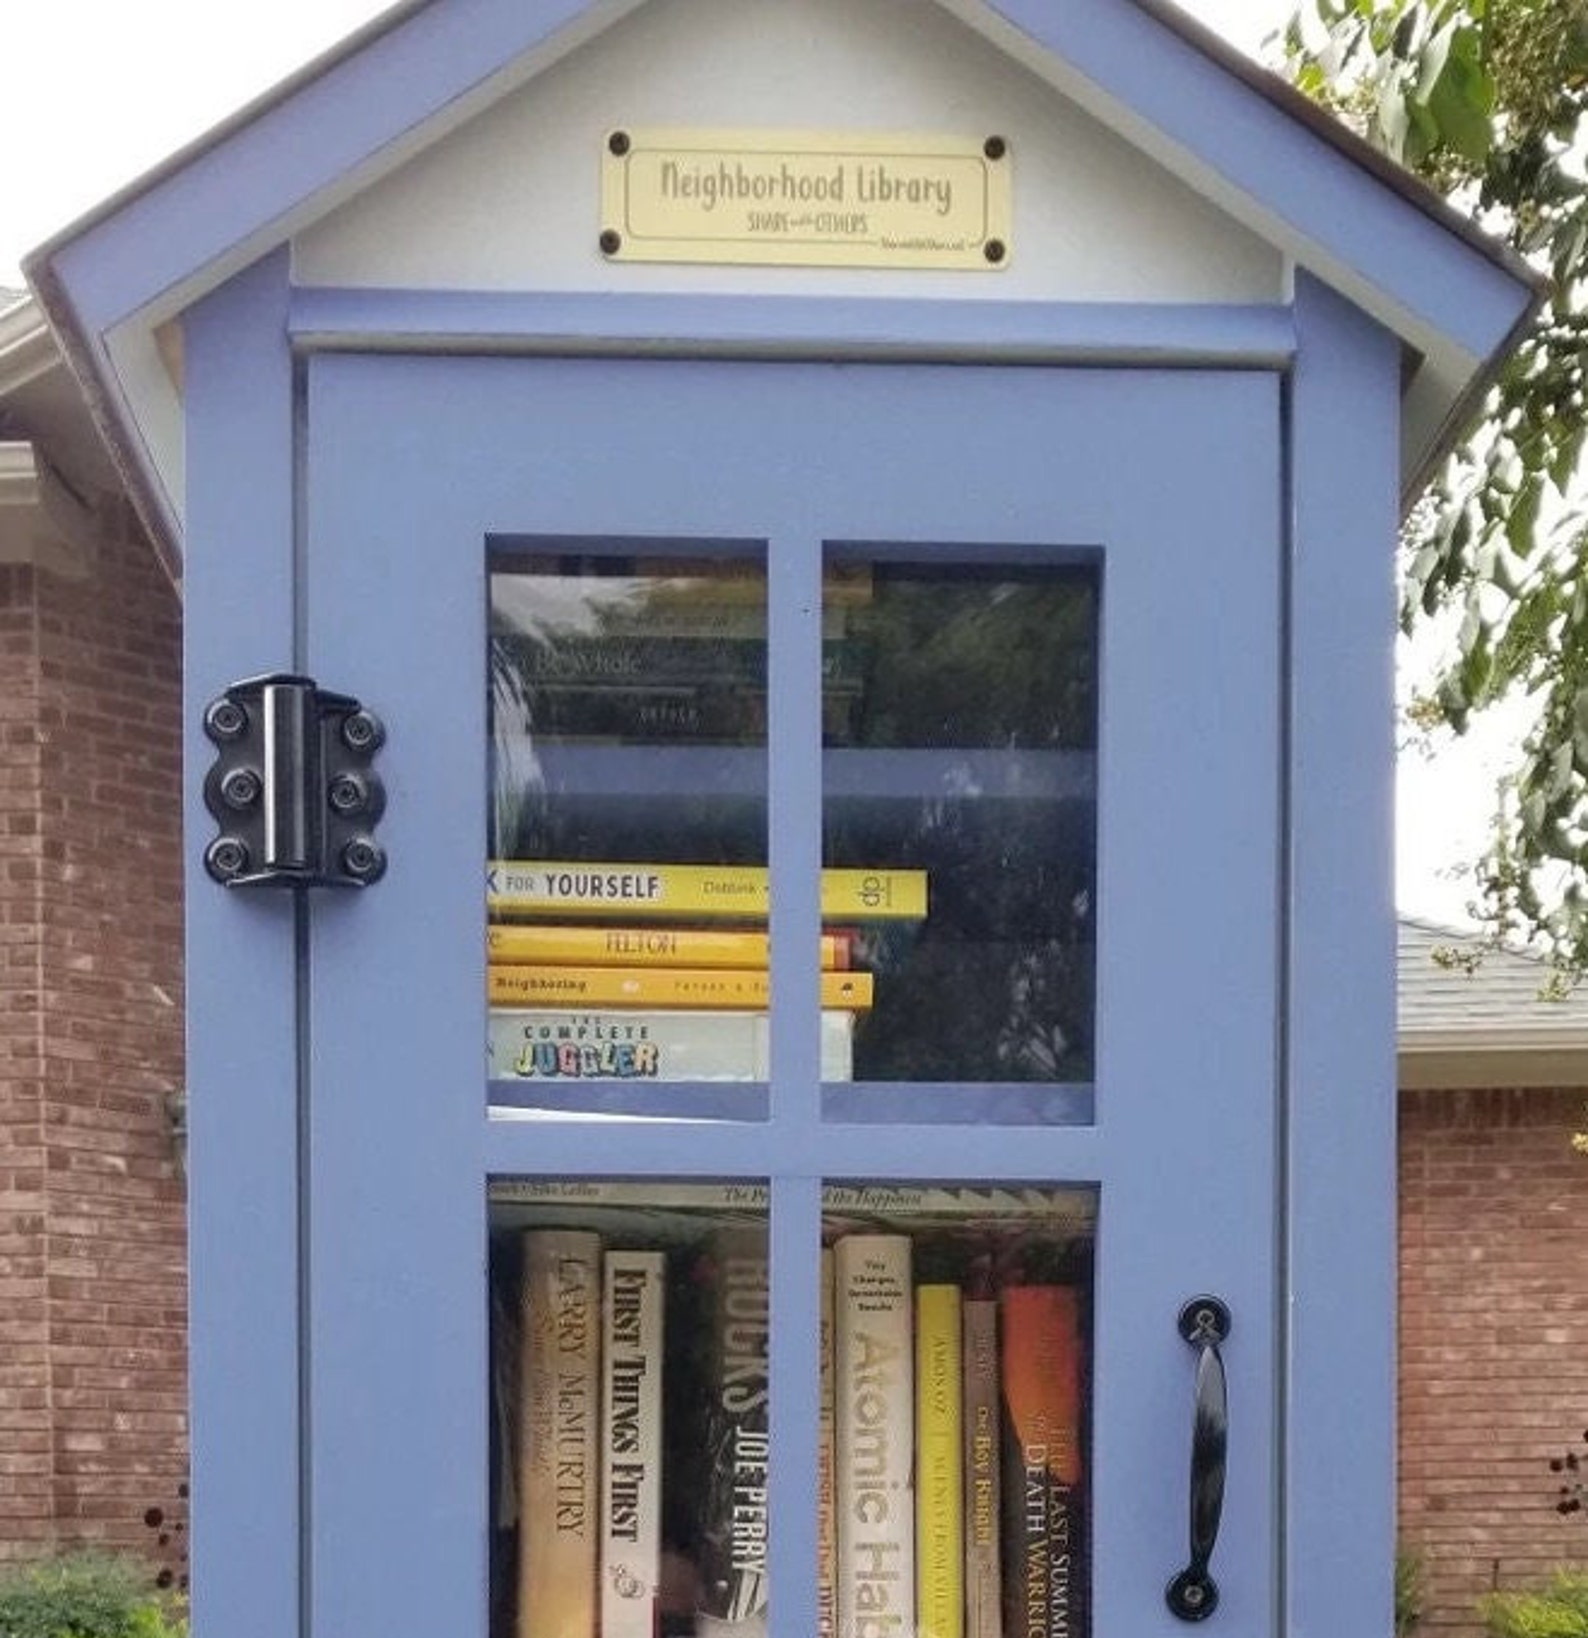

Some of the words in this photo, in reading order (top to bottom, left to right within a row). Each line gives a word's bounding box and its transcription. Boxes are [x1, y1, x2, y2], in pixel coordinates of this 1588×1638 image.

[660, 161, 844, 211] Neighborhood
[857, 162, 952, 215] Library
[747, 211, 788, 232] SHARE
[814, 212, 869, 234] OTHERS
[505, 875, 535, 893] FOR
[545, 873, 660, 900] YOURSELF
[513, 1043, 659, 1078] JUGGLER
[523, 1025, 649, 1040] COMPLETE
[557, 1256, 587, 1360] LARRY
[611, 1268, 648, 1346] FIRST
[722, 1257, 768, 1414] ROCKS
[931, 1333, 947, 1387] AMOS
[611, 1356, 647, 1455] THINGS
[852, 1330, 900, 1524] Atomic
[931, 1391, 947, 1415] OZ
[556, 1372, 587, 1538] McMURTRY
[733, 1427, 768, 1480] JOE
[972, 1434, 992, 1472] Boy
[610, 1464, 645, 1542] FIRST
[973, 1478, 992, 1545] Knight
[1025, 1443, 1047, 1533] DEATH
[1049, 1485, 1070, 1545] LAST
[732, 1486, 768, 1575] PERRY
